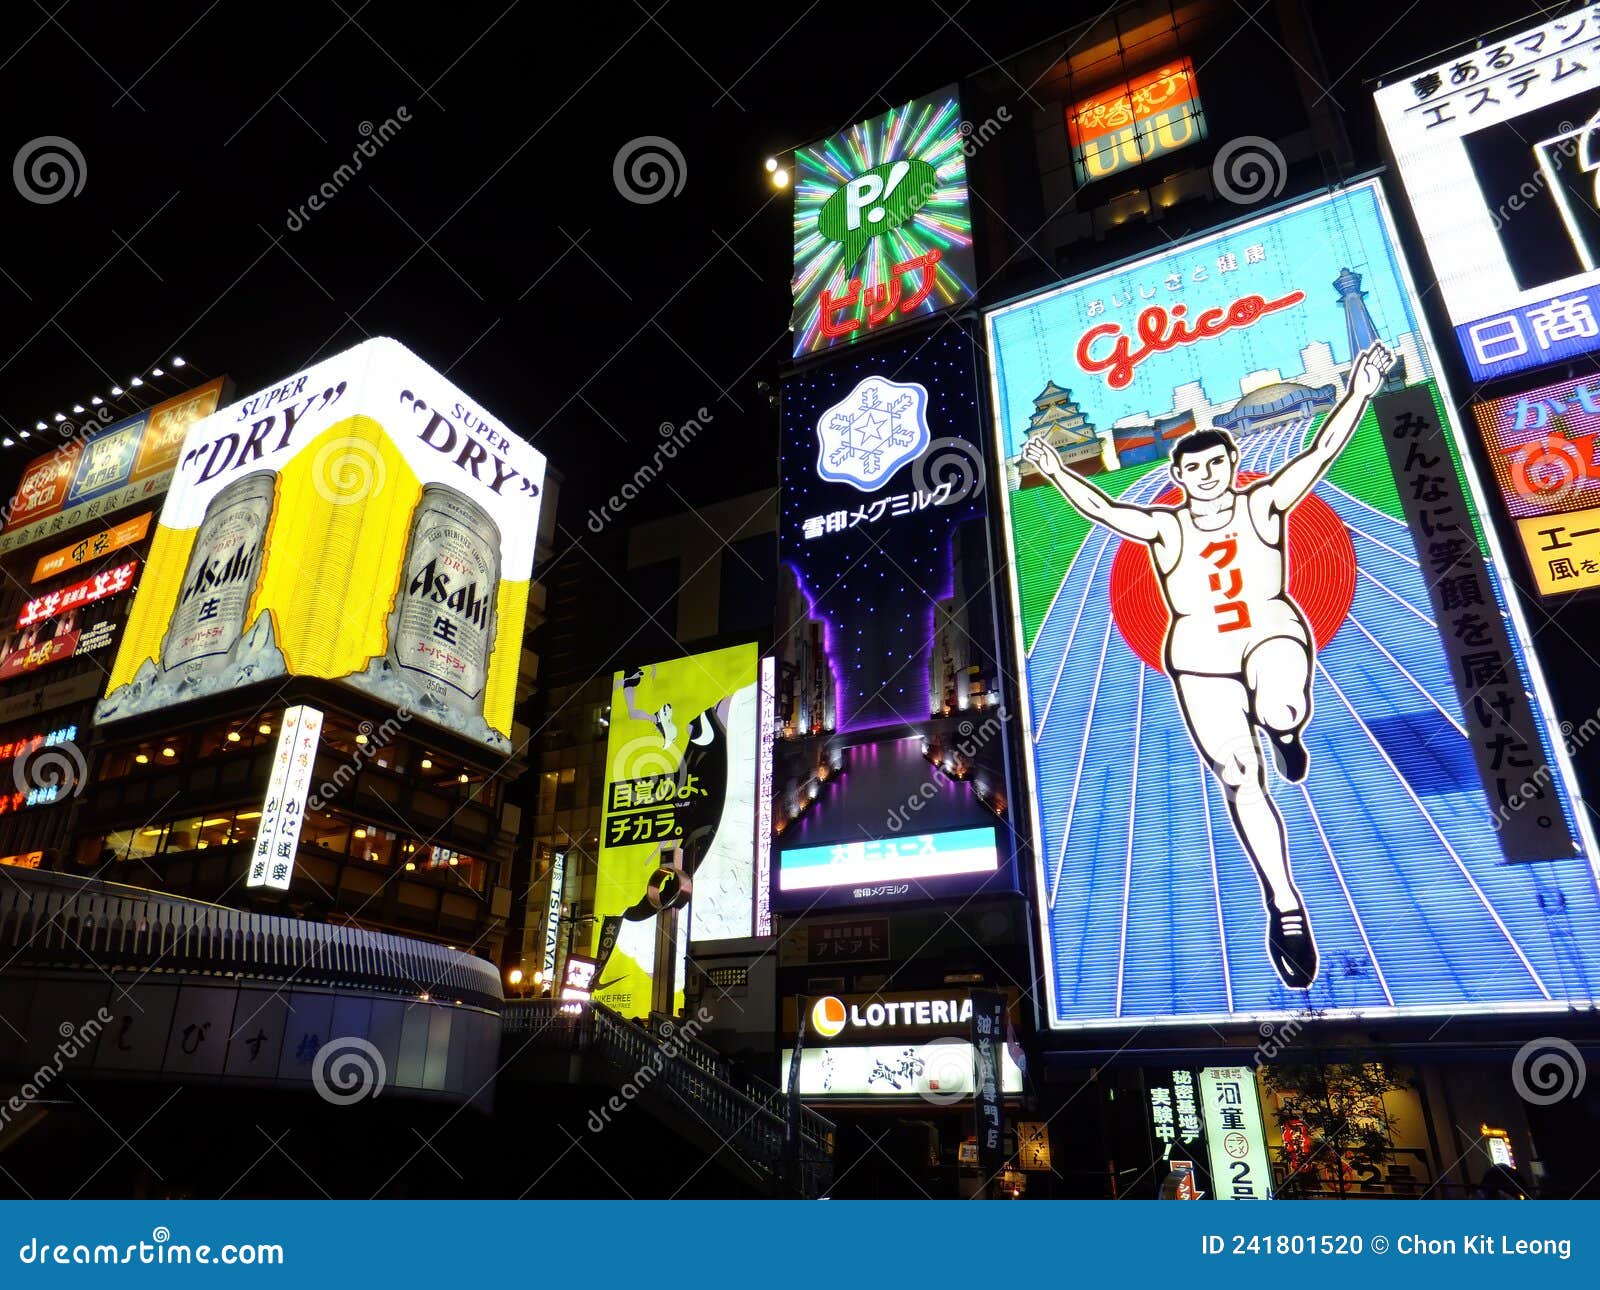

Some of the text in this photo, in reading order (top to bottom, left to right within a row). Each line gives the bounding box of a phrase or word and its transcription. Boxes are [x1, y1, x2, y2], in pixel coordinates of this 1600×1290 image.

[1422, 44, 1600, 129] エステム
[819, 248, 942, 337] ピップ
[1087, 243, 1266, 318] おいしさと健康
[1469, 295, 1600, 365] 日商
[237, 375, 309, 422] SUPER
[451, 401, 512, 456] SUPER
[802, 482, 952, 539] 雪印メグミルク
[181, 541, 257, 605] Asahi
[410, 558, 489, 631] Asahi
[1199, 532, 1252, 633] グリコ
[198, 598, 220, 622] 生
[433, 616, 458, 646] 生
[611, 813, 683, 843] チカラ。
[544, 889, 560, 970] TSUTAYA
[613, 994, 631, 1002] FREE
[851, 999, 973, 1027] LOTTERIA
